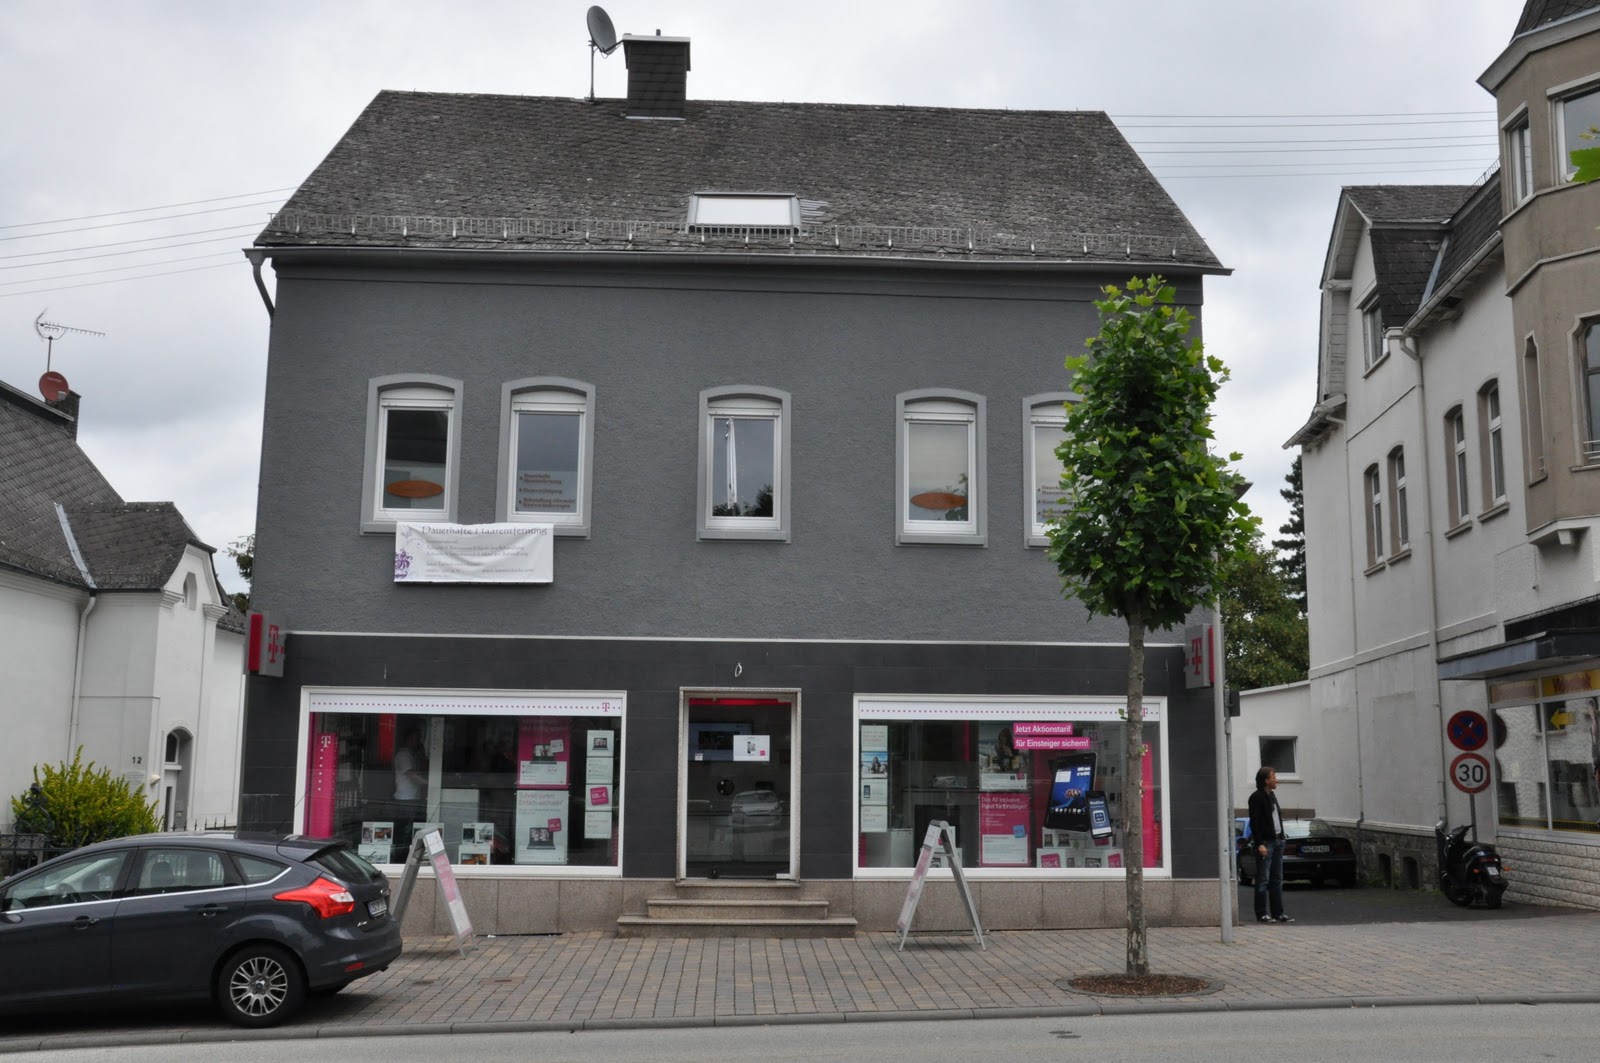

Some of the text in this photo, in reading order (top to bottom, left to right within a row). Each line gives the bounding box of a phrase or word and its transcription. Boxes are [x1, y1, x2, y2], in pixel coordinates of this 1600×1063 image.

[422, 526, 472, 536] Dauerhafte
[1015, 725, 1071, 733] Jetzt Aktionstarif
[1016, 739, 1088, 749] für Einsteiger sichern!
[131, 756, 142, 764] 12
[1459, 764, 1483, 783] 30
